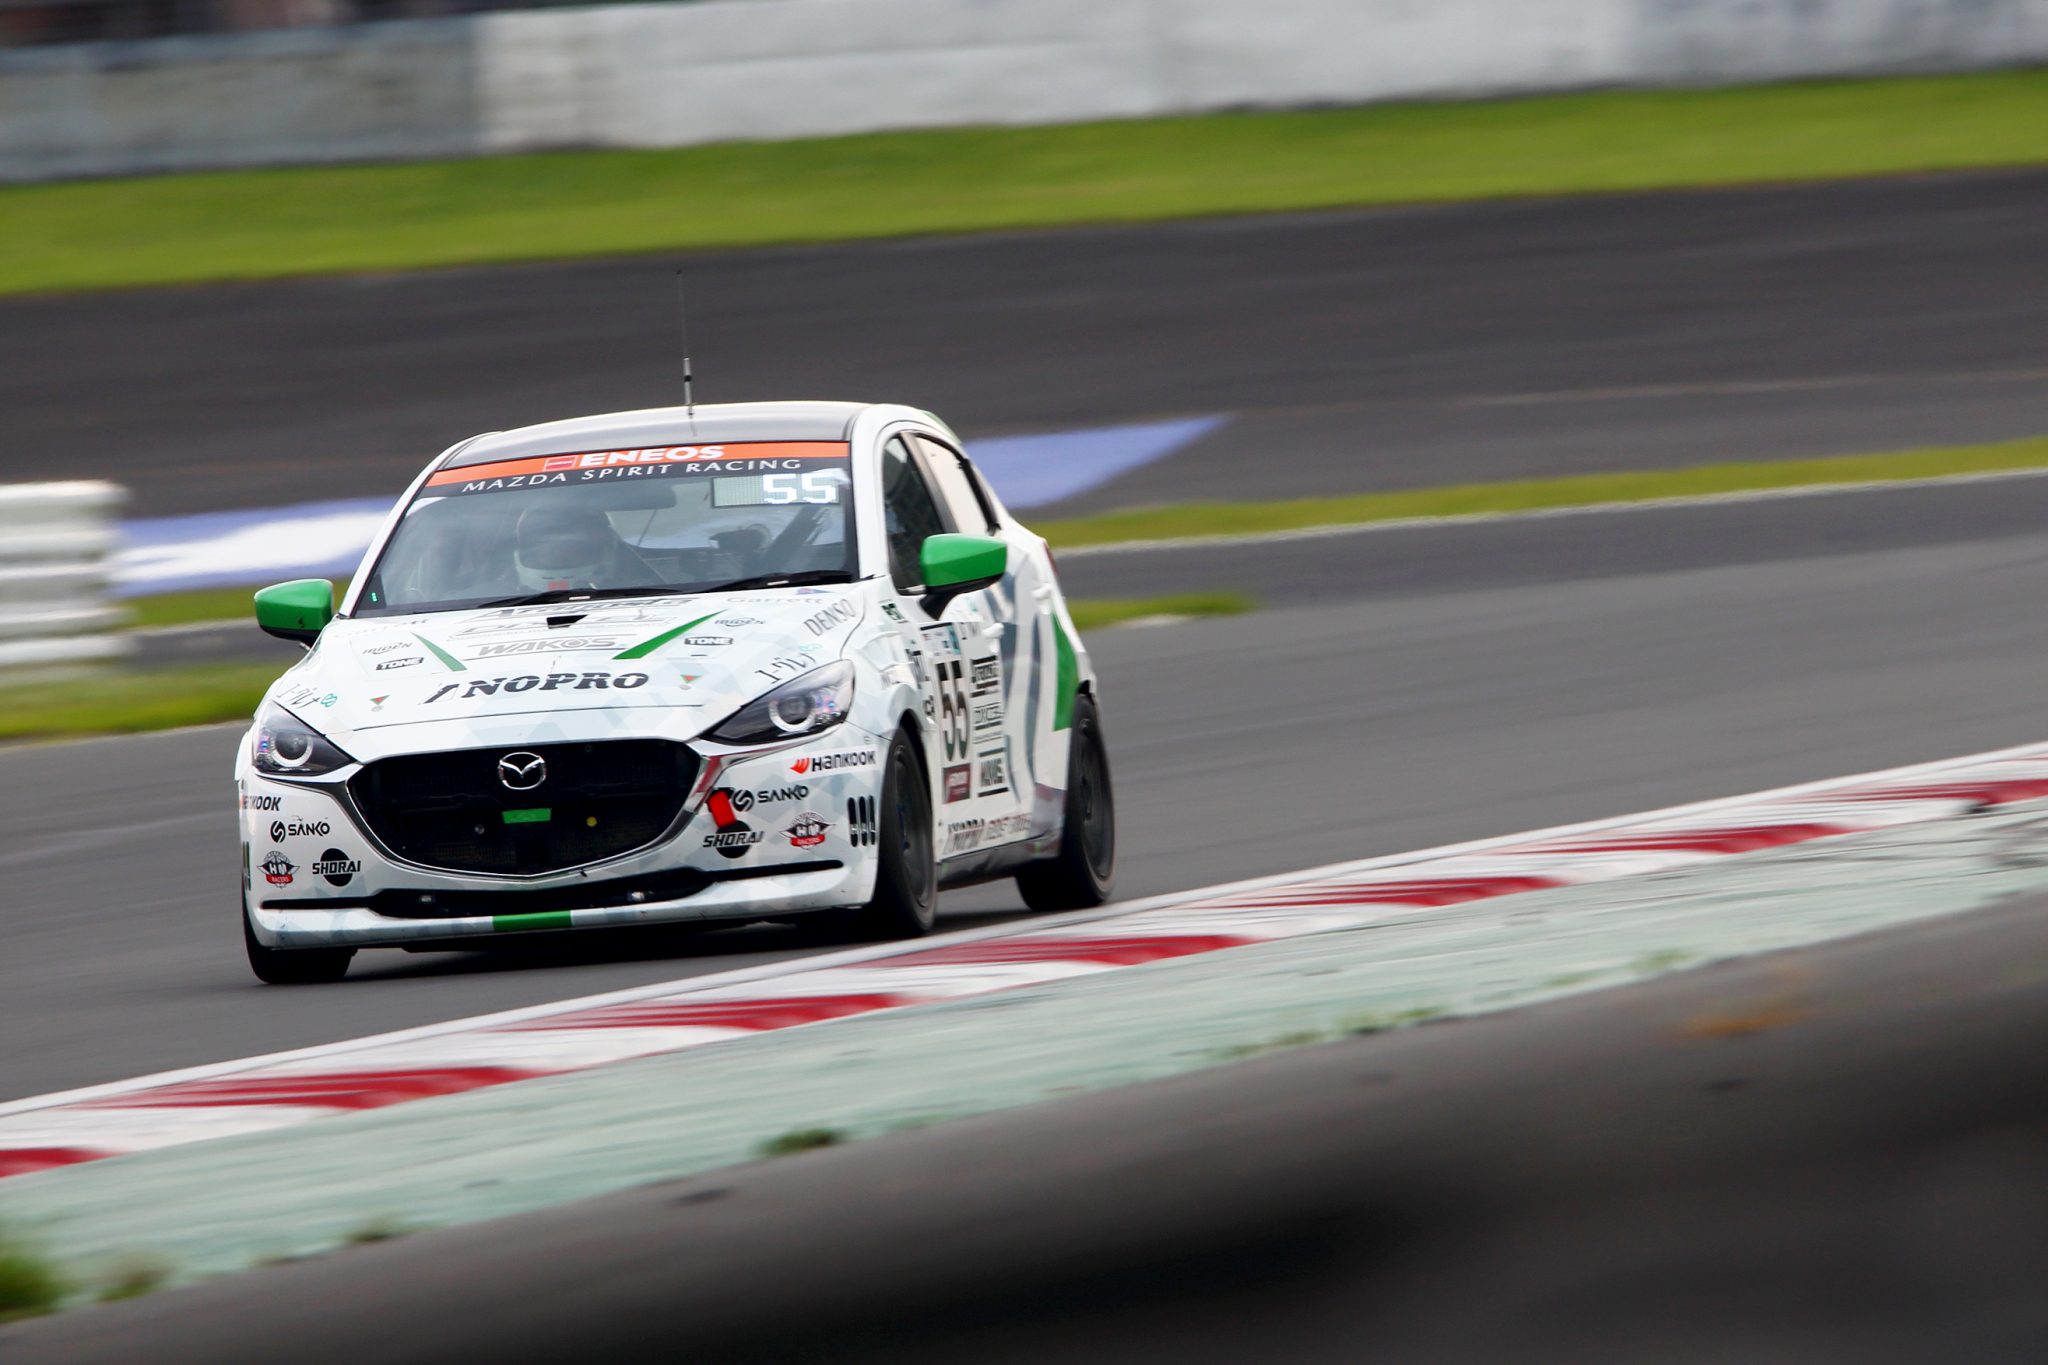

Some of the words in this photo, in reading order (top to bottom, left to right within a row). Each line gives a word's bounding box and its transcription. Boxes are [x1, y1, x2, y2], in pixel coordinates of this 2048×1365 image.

[579, 445, 725, 468] ENEOS
[461, 472, 568, 493] MAZDA
[582, 464, 669, 480] SPIRIT
[685, 458, 802, 473] RACING
[762, 473, 837, 505] 55
[803, 598, 856, 637] DENSO
[687, 637, 732, 646] TONE
[378, 657, 423, 671] TONE
[461, 672, 649, 698] NOPRO
[935, 659, 970, 762] 55
[757, 784, 809, 803] SANKO
[287, 821, 331, 837] SANKO
[702, 831, 764, 848] SHORAI
[312, 860, 361, 875] SHORAI
